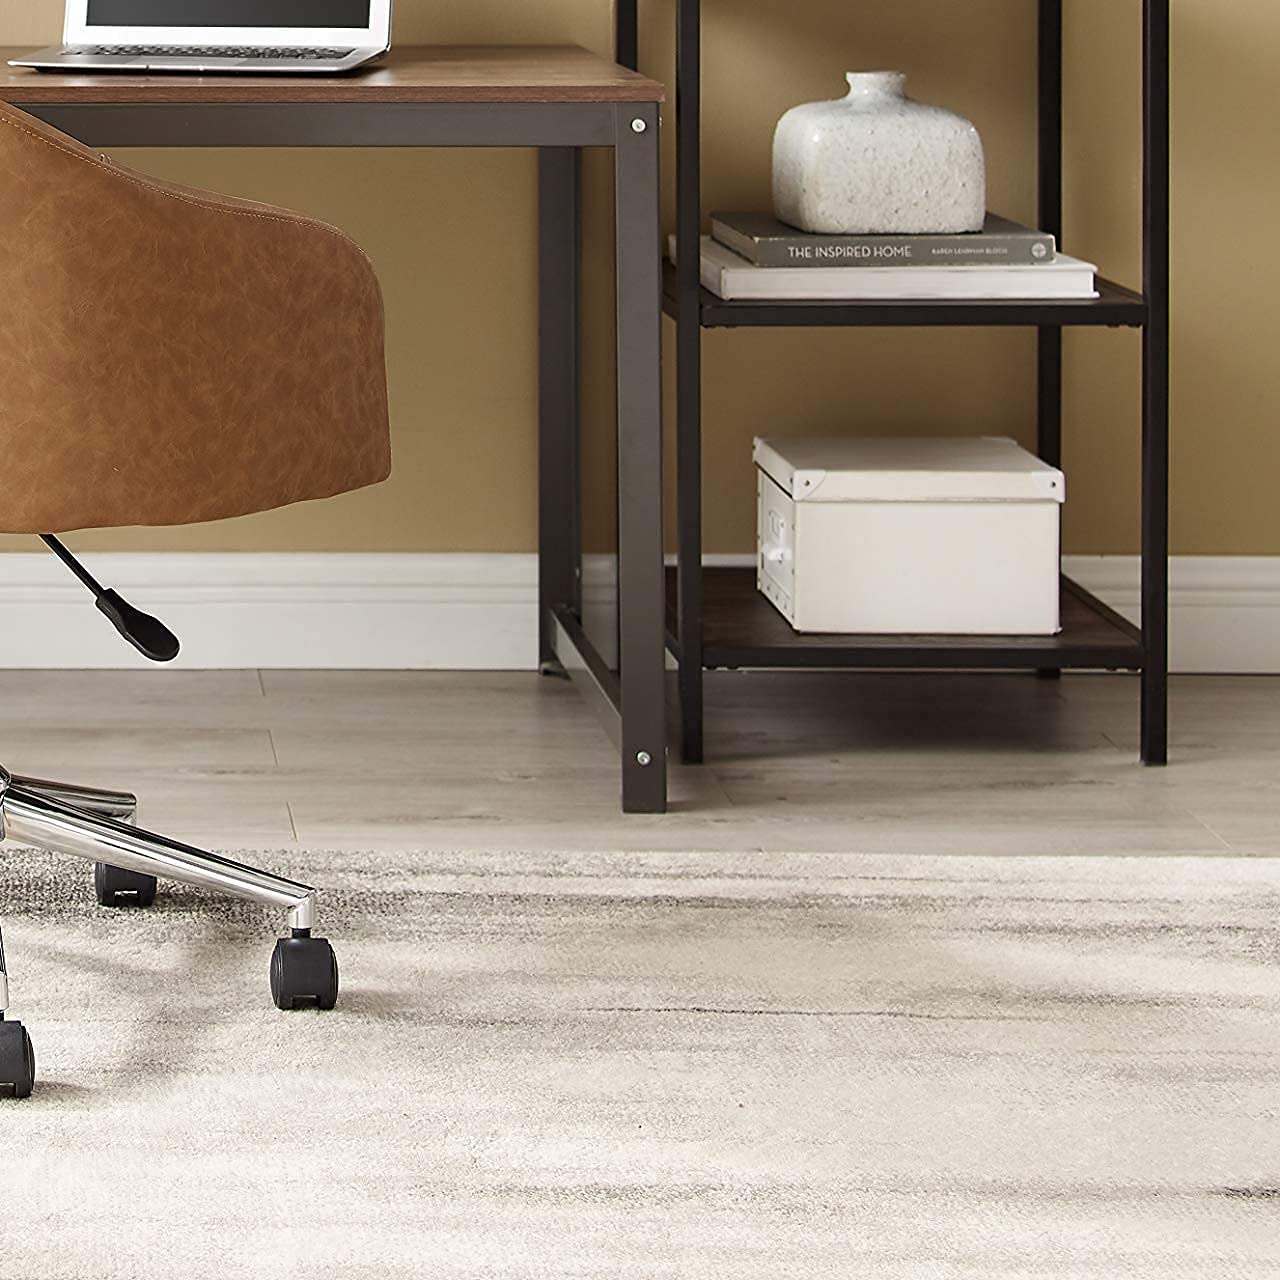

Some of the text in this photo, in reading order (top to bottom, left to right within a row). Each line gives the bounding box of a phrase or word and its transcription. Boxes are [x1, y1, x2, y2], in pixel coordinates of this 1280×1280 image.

[787, 245, 912, 258] THE INSPIRED HOME
